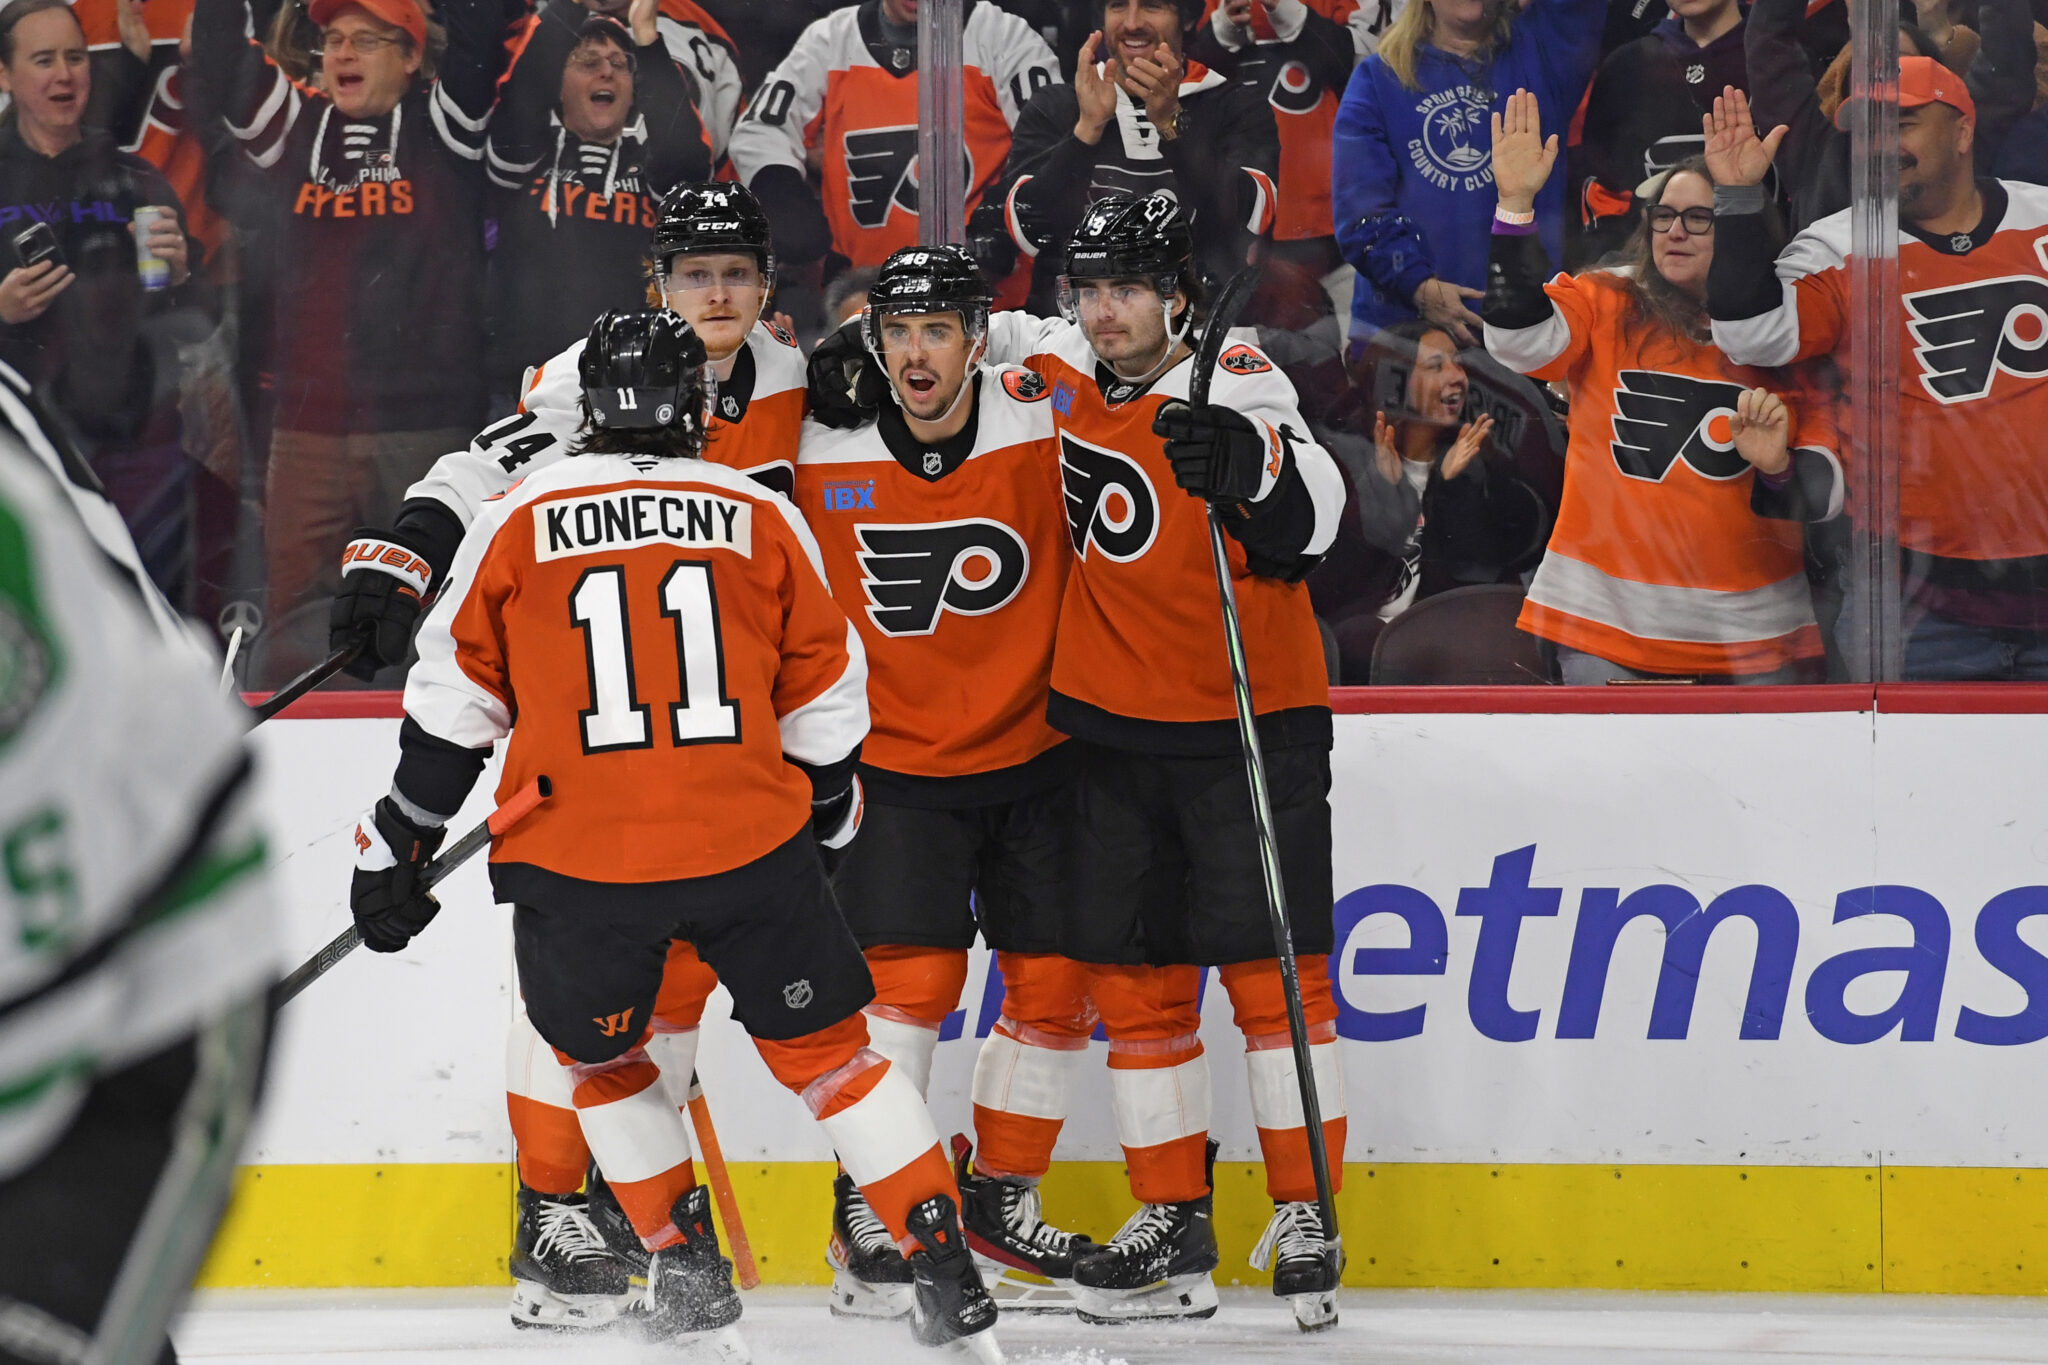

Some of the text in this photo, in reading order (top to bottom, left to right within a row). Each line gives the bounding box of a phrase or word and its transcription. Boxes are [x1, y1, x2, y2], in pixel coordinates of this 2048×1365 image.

[1415, 85, 1498, 114] SPRINGFIE
[1408, 139, 1495, 192] COUNTRY CLU
[294, 180, 414, 218] FYERS
[697, 222, 739, 231] CCM
[891, 285, 931, 295] CCM
[617, 387, 637, 410] 11
[824, 487, 876, 511] IBX
[546, 495, 738, 552] KONECNY
[342, 543, 431, 583] AUER
[568, 559, 743, 756] 11
[935, 843, 2048, 1047] etmas
[1004, 1235, 1045, 1259] CCM
